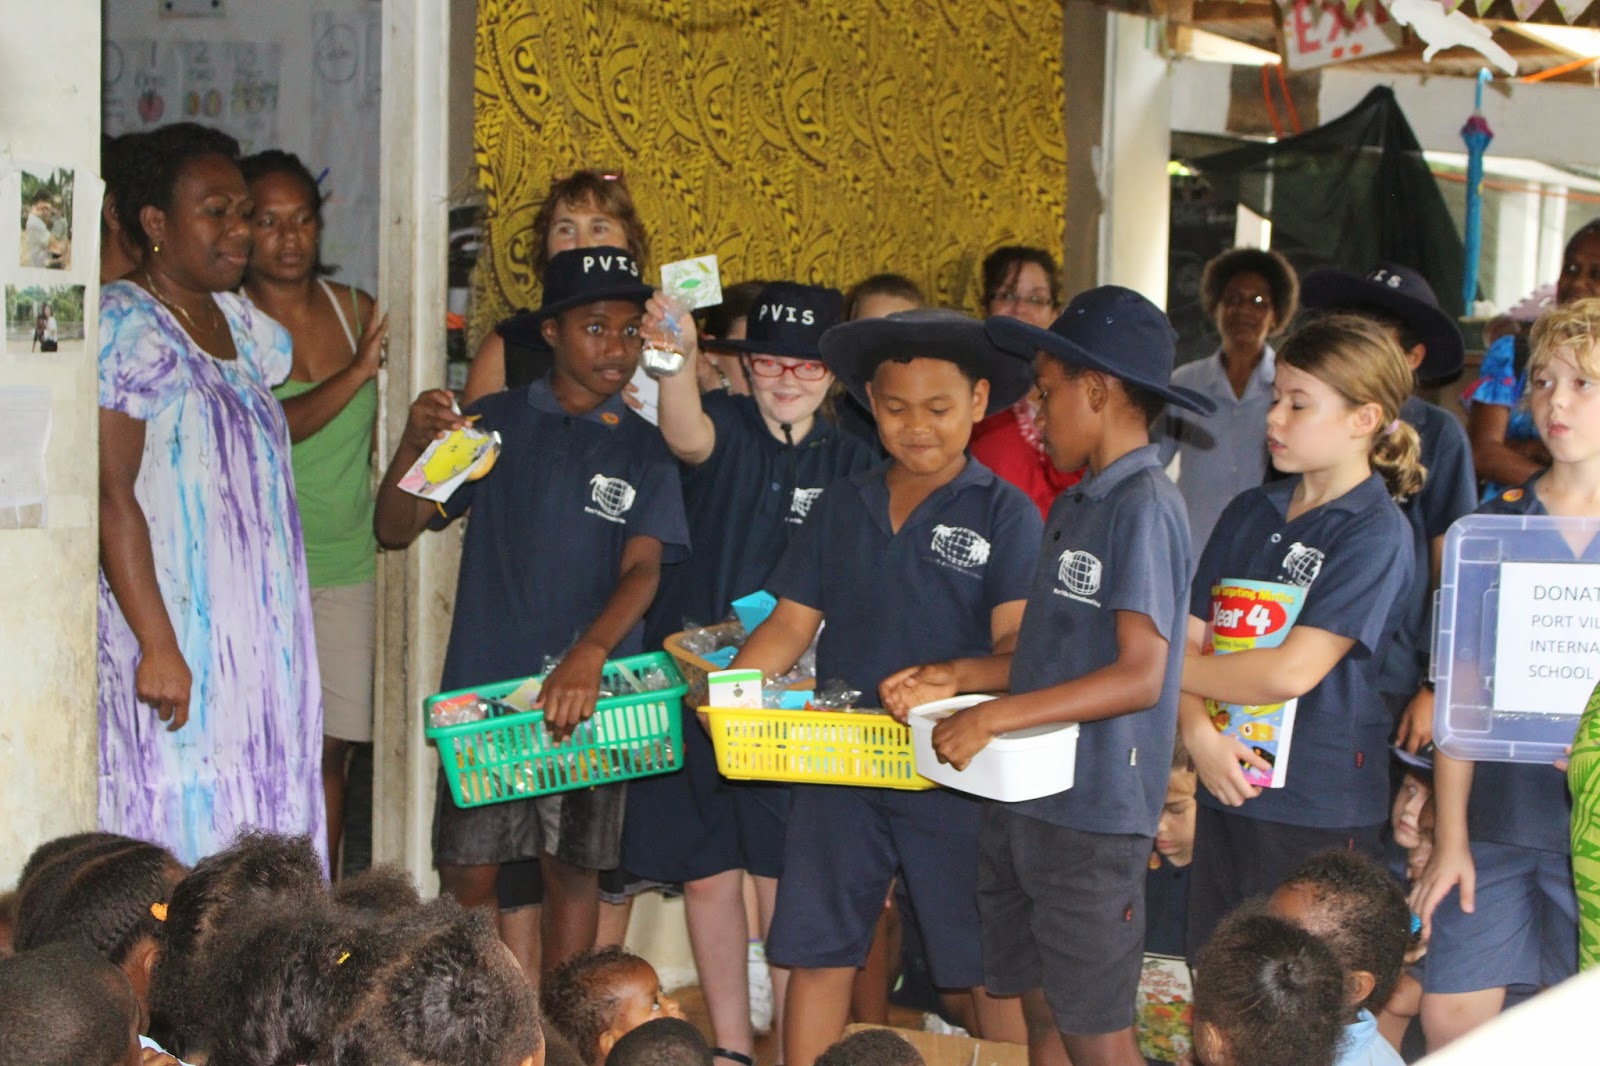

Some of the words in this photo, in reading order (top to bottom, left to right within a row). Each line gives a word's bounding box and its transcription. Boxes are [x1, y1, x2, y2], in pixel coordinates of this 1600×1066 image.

[583, 254, 639, 277] PVIS
[758, 303, 815, 326] PVIS
[1533, 585, 1600, 602] DONAT
[1213, 601, 1244, 629] Year
[1246, 604, 1272, 635] 4
[1531, 614, 1573, 628] PORT
[1578, 615, 1600, 630] VIL
[1530, 639, 1600, 654] INTERNA
[1528, 664, 1594, 680] SCHOOL
